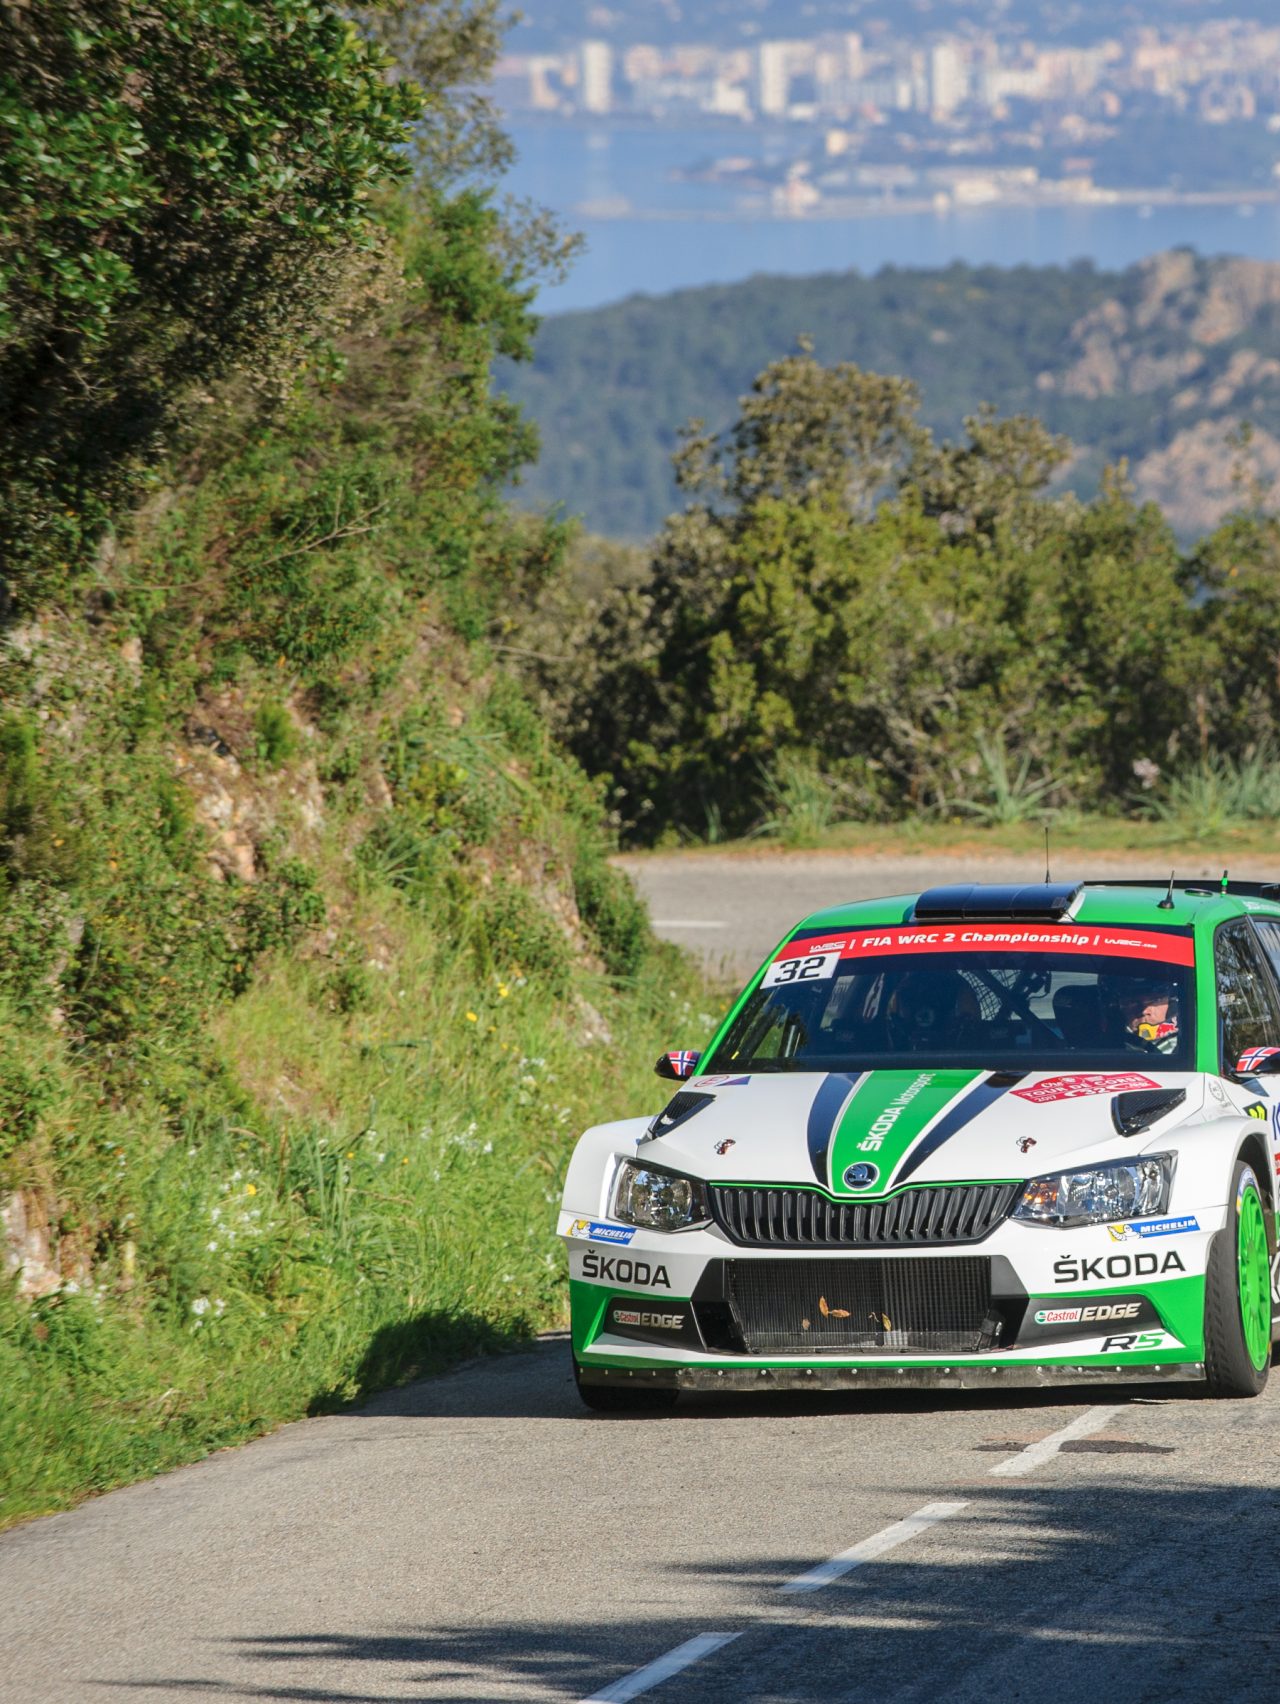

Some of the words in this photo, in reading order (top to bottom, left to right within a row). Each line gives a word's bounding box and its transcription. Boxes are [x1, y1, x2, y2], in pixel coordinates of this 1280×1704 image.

[862, 937, 891, 948] FIA
[898, 933, 939, 945] WRC
[943, 933, 954, 942] 2
[961, 932, 1089, 946] Championship
[774, 956, 826, 984] 32
[1022, 1087, 1068, 1098] TOUR
[1069, 1083, 1092, 1091] DE
[1094, 1076, 1146, 1086] CORSE
[856, 1106, 906, 1152] ŠKODA
[592, 1228, 634, 1239] MICHELIN
[1140, 1219, 1196, 1233] MICHELIN
[582, 1249, 671, 1288] ŠKODA
[1053, 1250, 1187, 1284] ŠKODA
[640, 1313, 685, 1329] EDGE
[1046, 1310, 1079, 1322] Castrol
[1081, 1302, 1142, 1322] EDGE
[1100, 1332, 1166, 1353] R5
